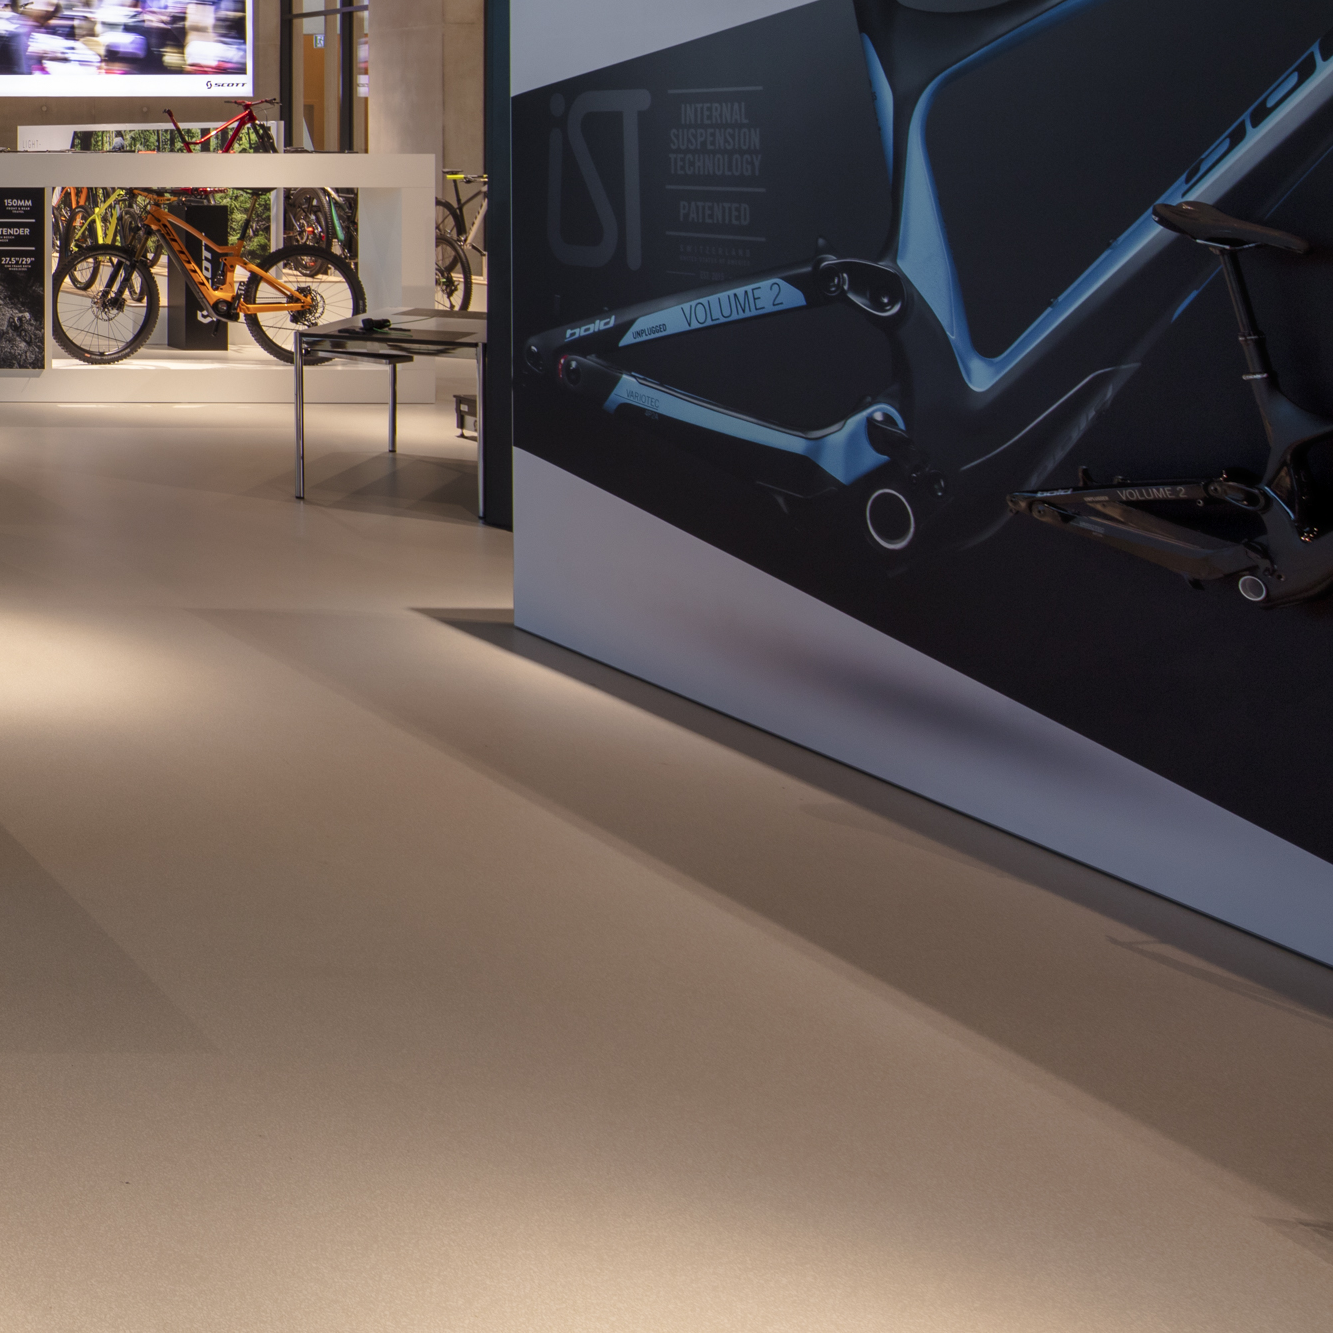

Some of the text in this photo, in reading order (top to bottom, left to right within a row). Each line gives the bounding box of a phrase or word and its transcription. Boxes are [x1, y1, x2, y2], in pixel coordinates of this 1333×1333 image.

[681, 102, 749, 124] INTERNAL
[670, 128, 760, 150] SUSPENSION
[668, 153, 762, 176] TECHNOLOGY
[4, 198, 32, 206] 150MM
[679, 201, 750, 226] PATENTED
[681, 282, 784, 327] VOLUME 2
[564, 315, 616, 342] bold
[632, 323, 667, 340] UNPLUGGED
[626, 389, 660, 409] VARIOTEC
[1116, 486, 1176, 501] VOLUME
[1177, 486, 1188, 498] 2
